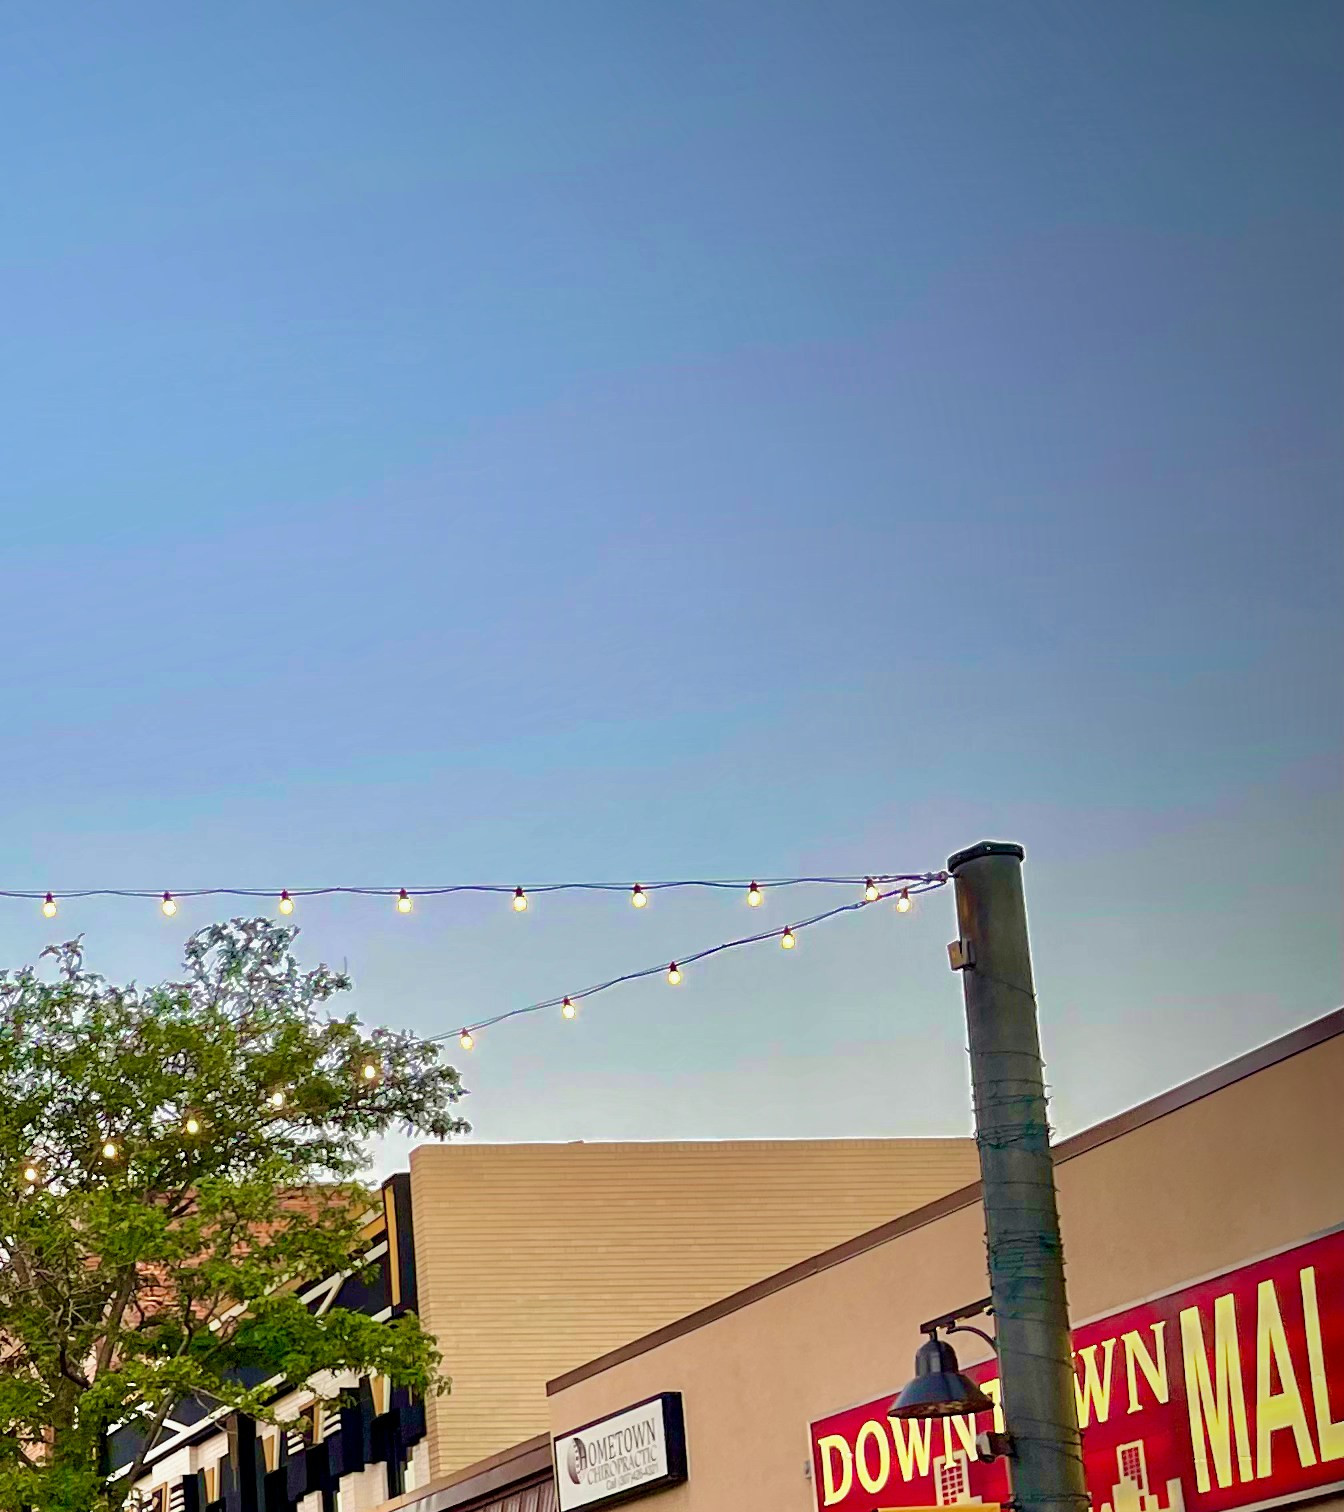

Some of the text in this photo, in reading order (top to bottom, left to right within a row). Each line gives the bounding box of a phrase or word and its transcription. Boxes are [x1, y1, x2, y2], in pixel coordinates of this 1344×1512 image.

[818, 1320, 1169, 1506] DOWNTWN
[578, 1417, 656, 1471] HOMETOWN
[587, 1445, 658, 1485] CHIROPRACTIC
